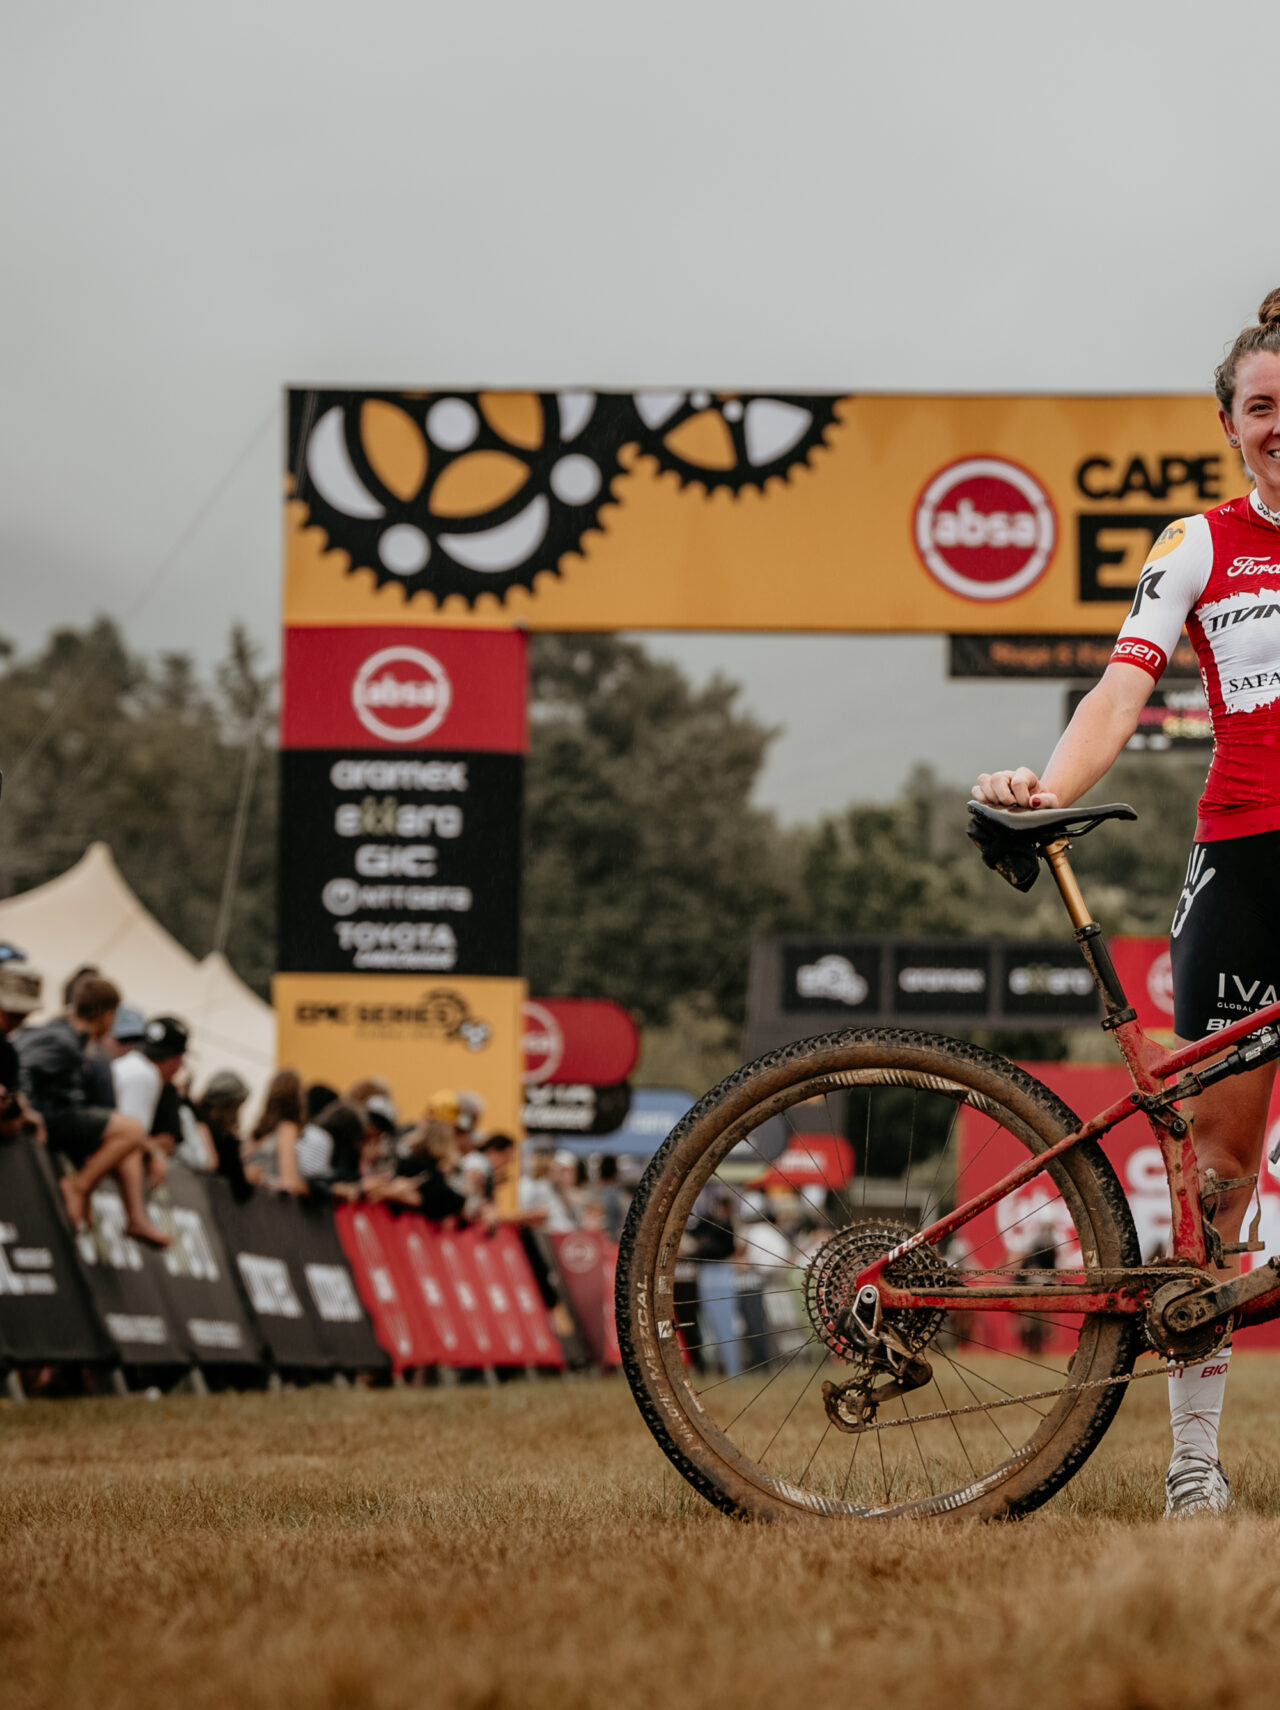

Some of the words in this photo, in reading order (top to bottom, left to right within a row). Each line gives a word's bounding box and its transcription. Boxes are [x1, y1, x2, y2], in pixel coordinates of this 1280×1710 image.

[1075, 456, 1221, 500] CAPE
[934, 499, 1036, 548] absa
[334, 922, 457, 950] TOYOTA
